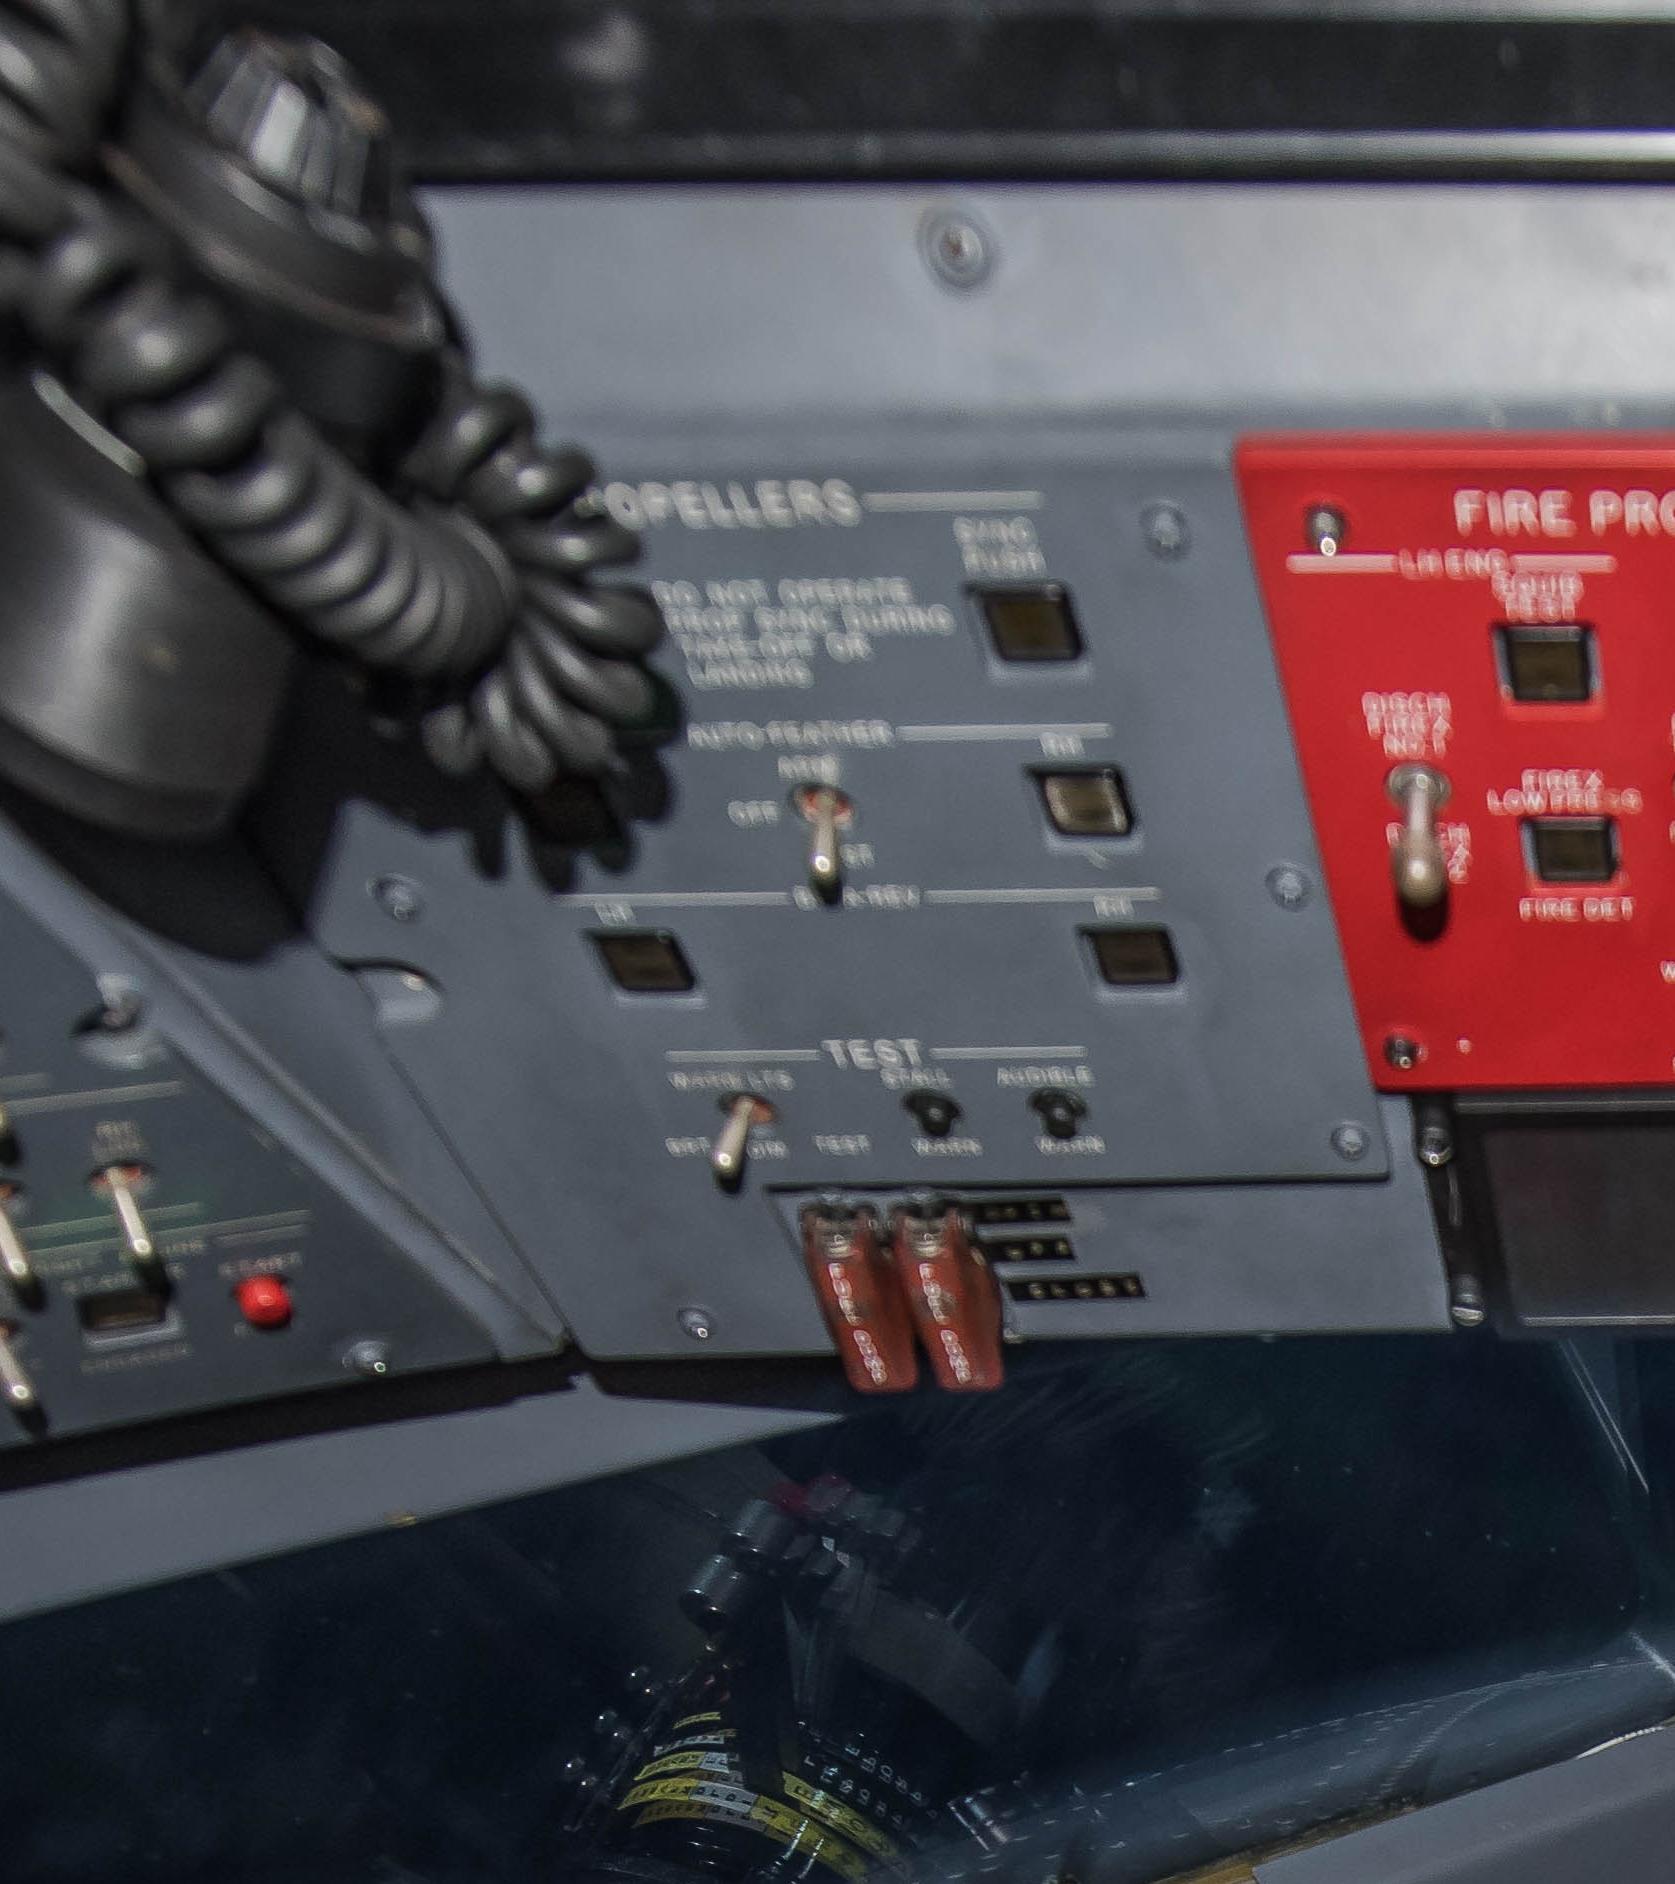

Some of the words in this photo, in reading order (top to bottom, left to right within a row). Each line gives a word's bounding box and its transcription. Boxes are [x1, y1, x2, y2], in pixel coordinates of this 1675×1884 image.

[577, 479, 862, 527] OPELLERS
[1453, 489, 1578, 538] FIRE
[820, 1037, 925, 1072] TEST
